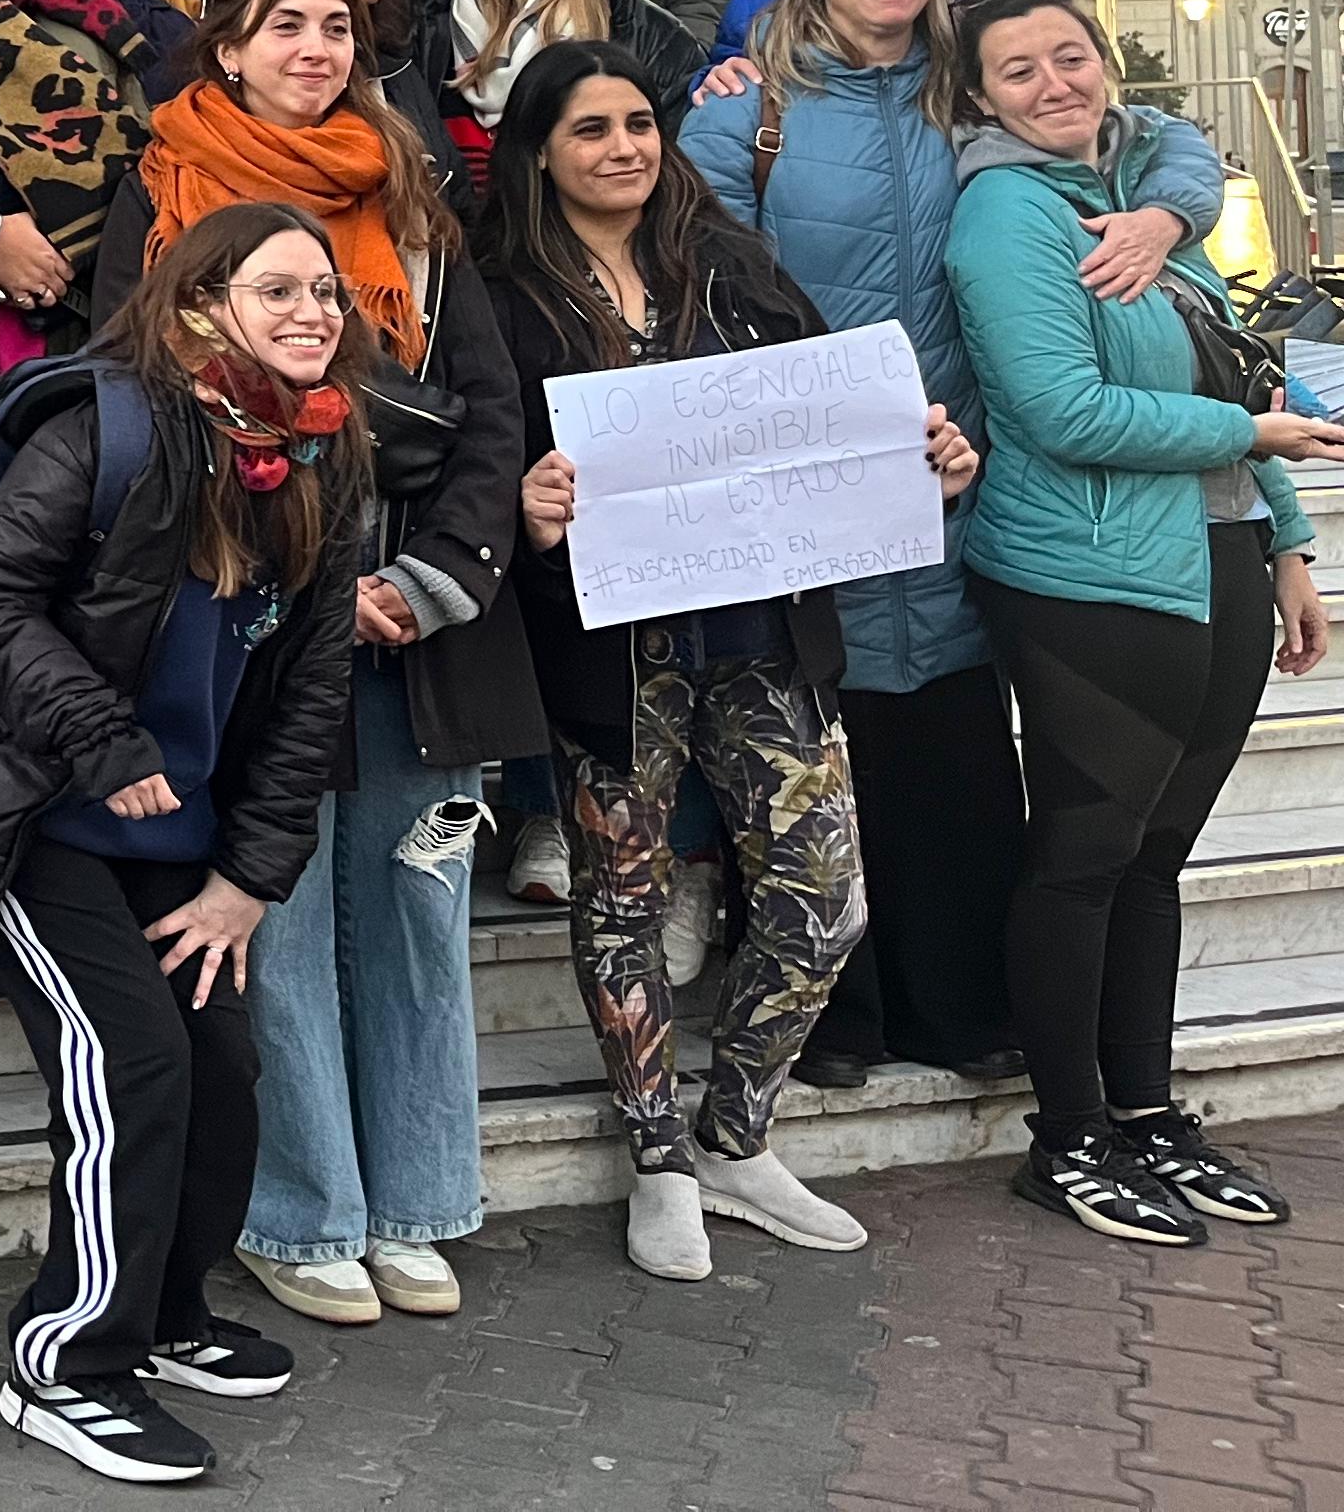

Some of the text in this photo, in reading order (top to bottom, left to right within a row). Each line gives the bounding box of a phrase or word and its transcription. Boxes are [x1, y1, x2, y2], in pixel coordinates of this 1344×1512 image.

[580, 387, 639, 439] LO
[880, 334, 916, 381] ES
[665, 449, 865, 527] AL ESTADO
[788, 528, 817, 552] EN
